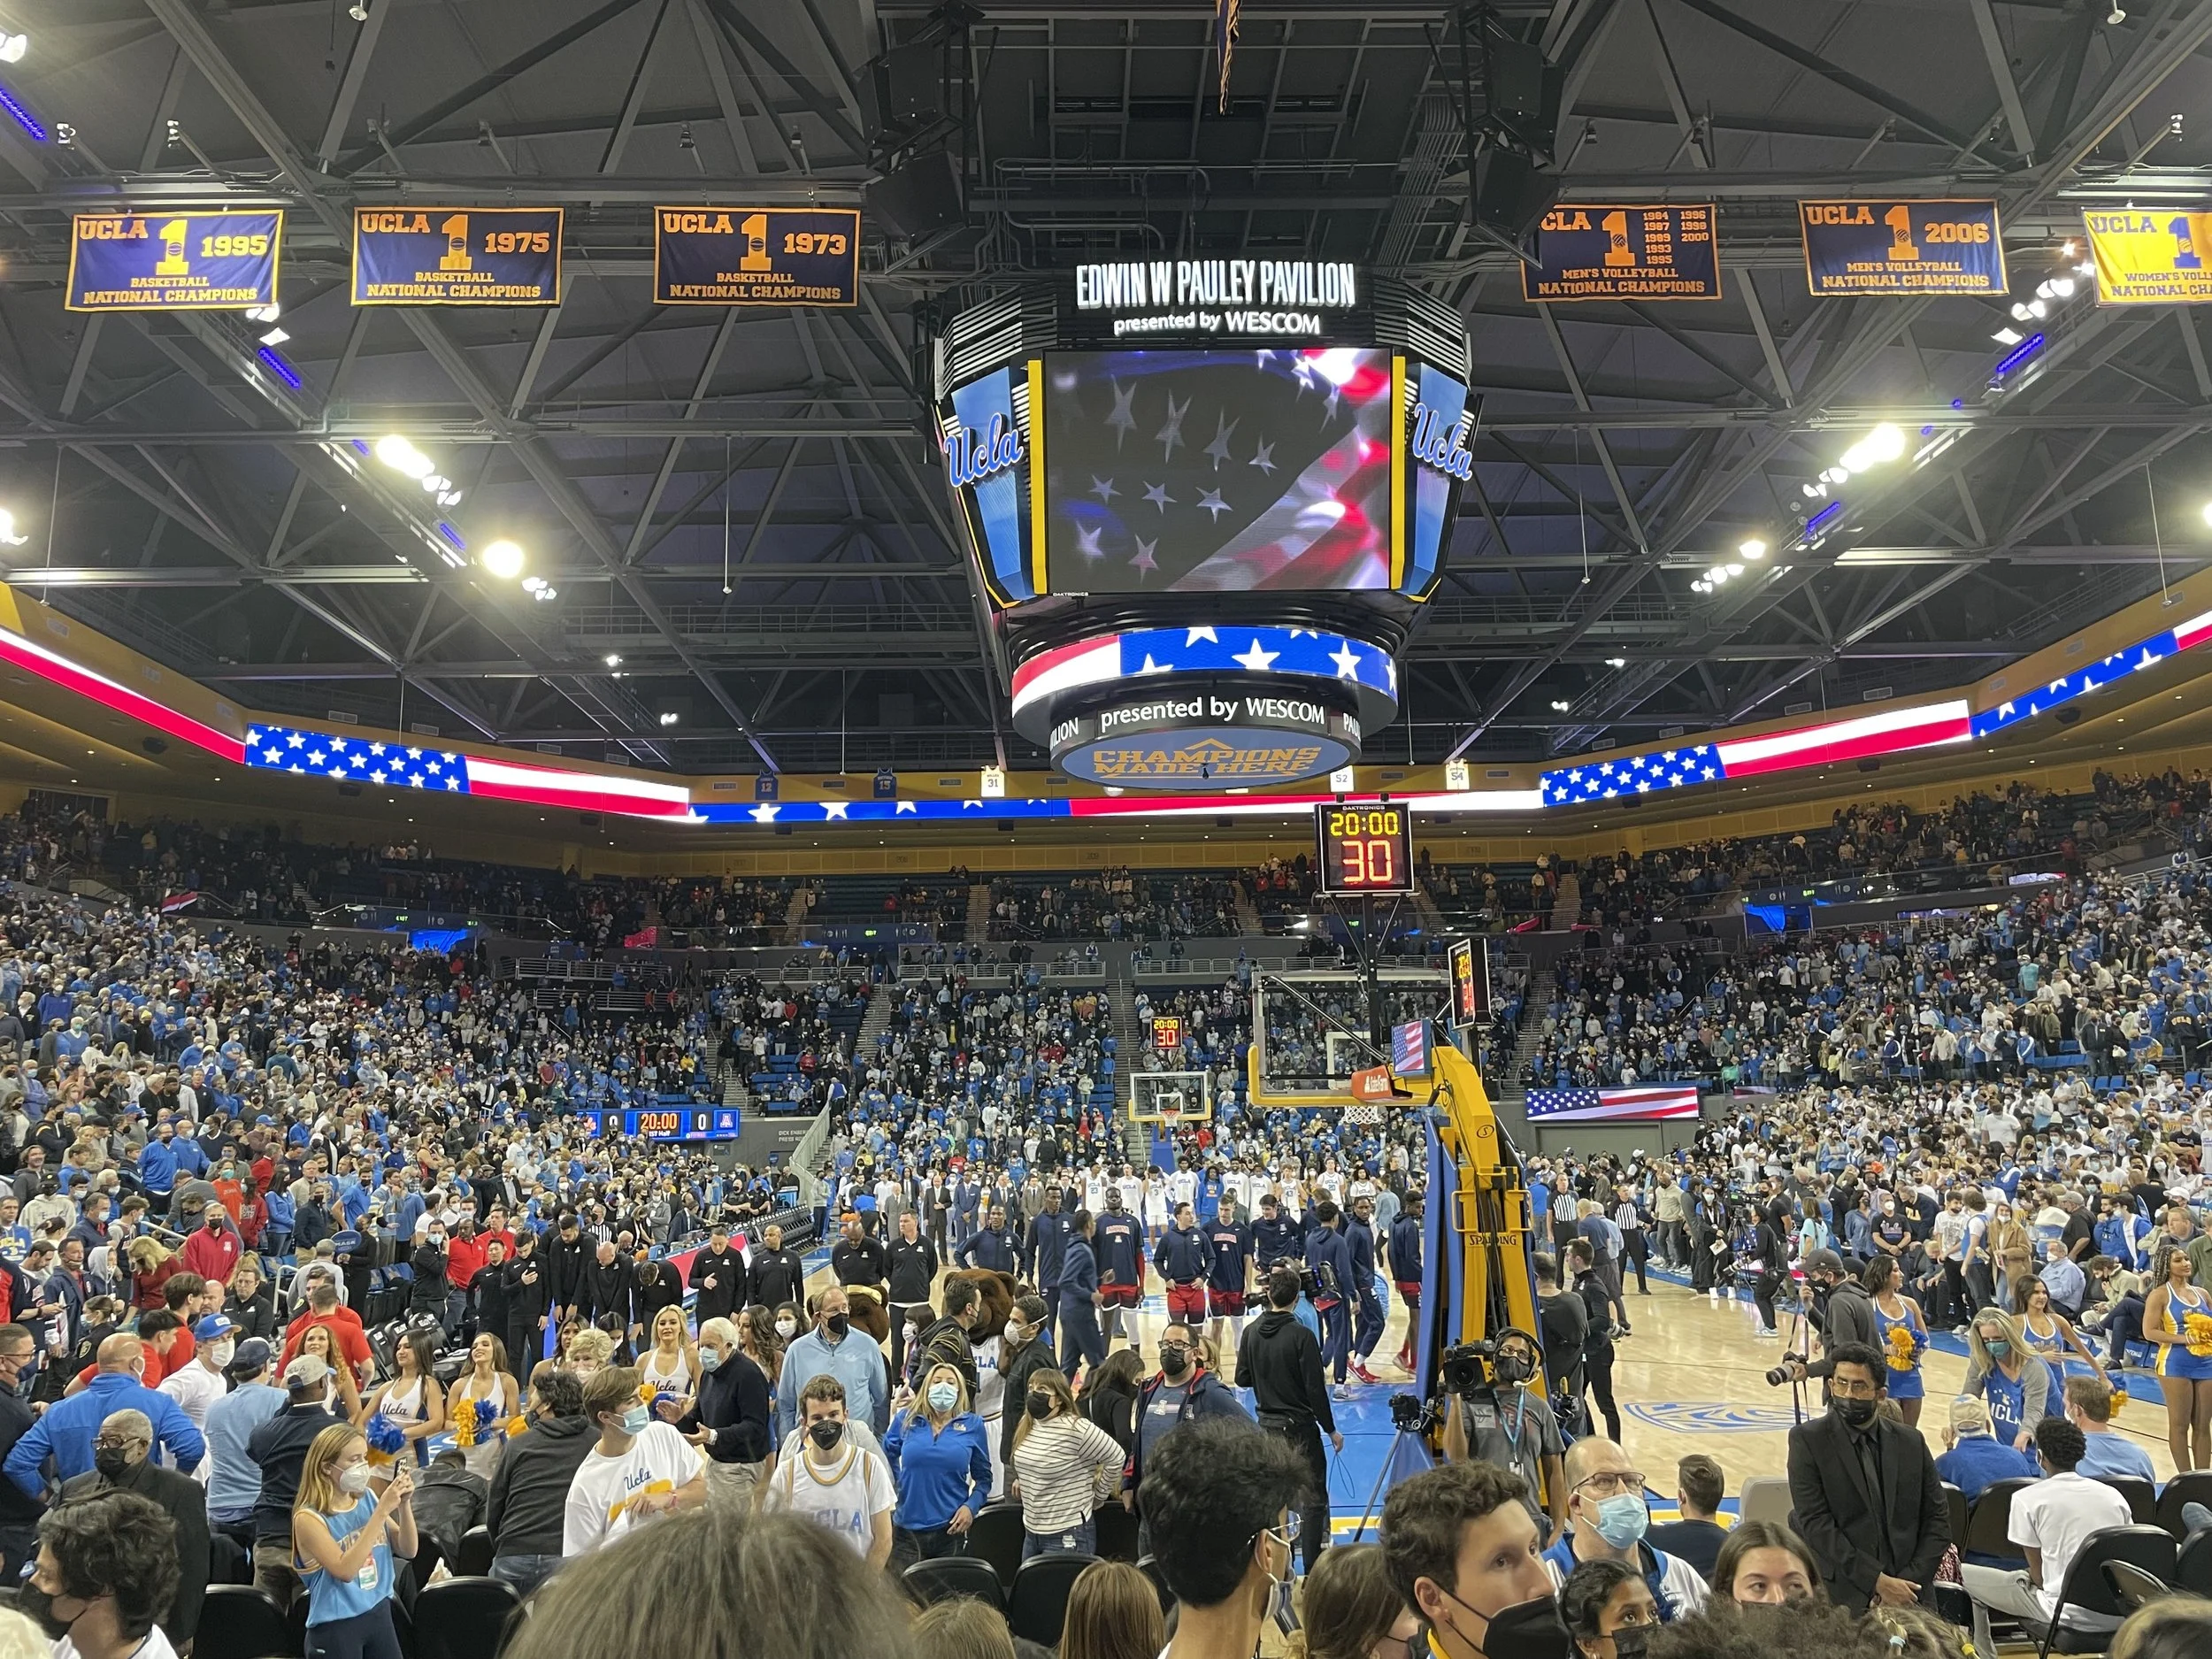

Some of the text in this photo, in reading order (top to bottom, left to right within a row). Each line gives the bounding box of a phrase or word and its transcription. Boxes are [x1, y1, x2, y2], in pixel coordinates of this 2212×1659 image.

[361, 214, 431, 234] UCLA
[664, 214, 733, 234] UCLA
[1540, 211, 1592, 231] CLA
[1643, 211, 1706, 220] 1984 1996
[1806, 206, 1875, 225] UCLA
[80, 219, 148, 240] UCLA
[1644, 222, 1670, 231] 1987
[1885, 206, 1919, 260] 1
[1924, 223, 1990, 243] 2006
[2092, 216, 2157, 234] UCLA
[201, 235, 267, 257] 1995
[440, 215, 472, 271] 1
[485, 233, 549, 253] 1975
[741, 214, 772, 272] 1
[784, 234, 847, 255] 1973
[1601, 211, 1636, 266] 1
[1645, 233, 1709, 242] 1989 2000
[2168, 217, 2202, 269] 1
[156, 219, 189, 275] 1
[1646, 244, 1671, 254] 1993
[1647, 255, 1673, 265] 1995
[1847, 262, 1962, 272] MEN'S VOLLEYBALL
[415, 273, 495, 282] BASKETBALL
[717, 273, 795, 283] BASKETBALL
[1563, 268, 1678, 279] MEN'S VOLLEYBALL
[1823, 274, 1989, 288] NATIONAL CHAMPIONS
[2124, 273, 2179, 282] WOMEN'S
[130, 277, 209, 288] BASKETBALL
[367, 284, 541, 298] NATIONAL CHAMPIONS
[1076, 260, 1356, 309] EDWIN W PAULEY PAVILION
[1539, 280, 1705, 295] NATIONAL CHAMPIONS
[2111, 285, 2187, 296] NATIONAL
[83, 288, 257, 304] NATIONAL CHAMPIONS
[670, 285, 841, 299] NATIONAL CHAMPIONS
[1113, 311, 1321, 336] presented by WESCOM
[943, 412, 1024, 488] Ucla
[1413, 403, 1472, 481] Ucla
[1050, 717, 1079, 751] LION
[1101, 696, 1202, 733] presented
[1210, 696, 1238, 721] by
[1246, 697, 1325, 725] WESCOM
[1094, 747, 1322, 764] CHAMPIONS
[1094, 760, 1315, 773] MADE HERE
[987, 779, 998, 787] 31
[1451, 772, 1463, 780] 54
[1331, 812, 1398, 836] 20:00
[1342, 840, 1392, 882] 30
[1154, 1019, 1178, 1029] 20:00
[1158, 1030, 1175, 1046] 30
[641, 1113, 678, 1130] 20:00
[698, 1114, 706, 1131] 0
[1470, 1234, 1517, 1246] SPING
[382, 1402, 408, 1416] Ucla
[624, 1468, 651, 1490] Ucla
[815, 1509, 864, 1533] CLA
